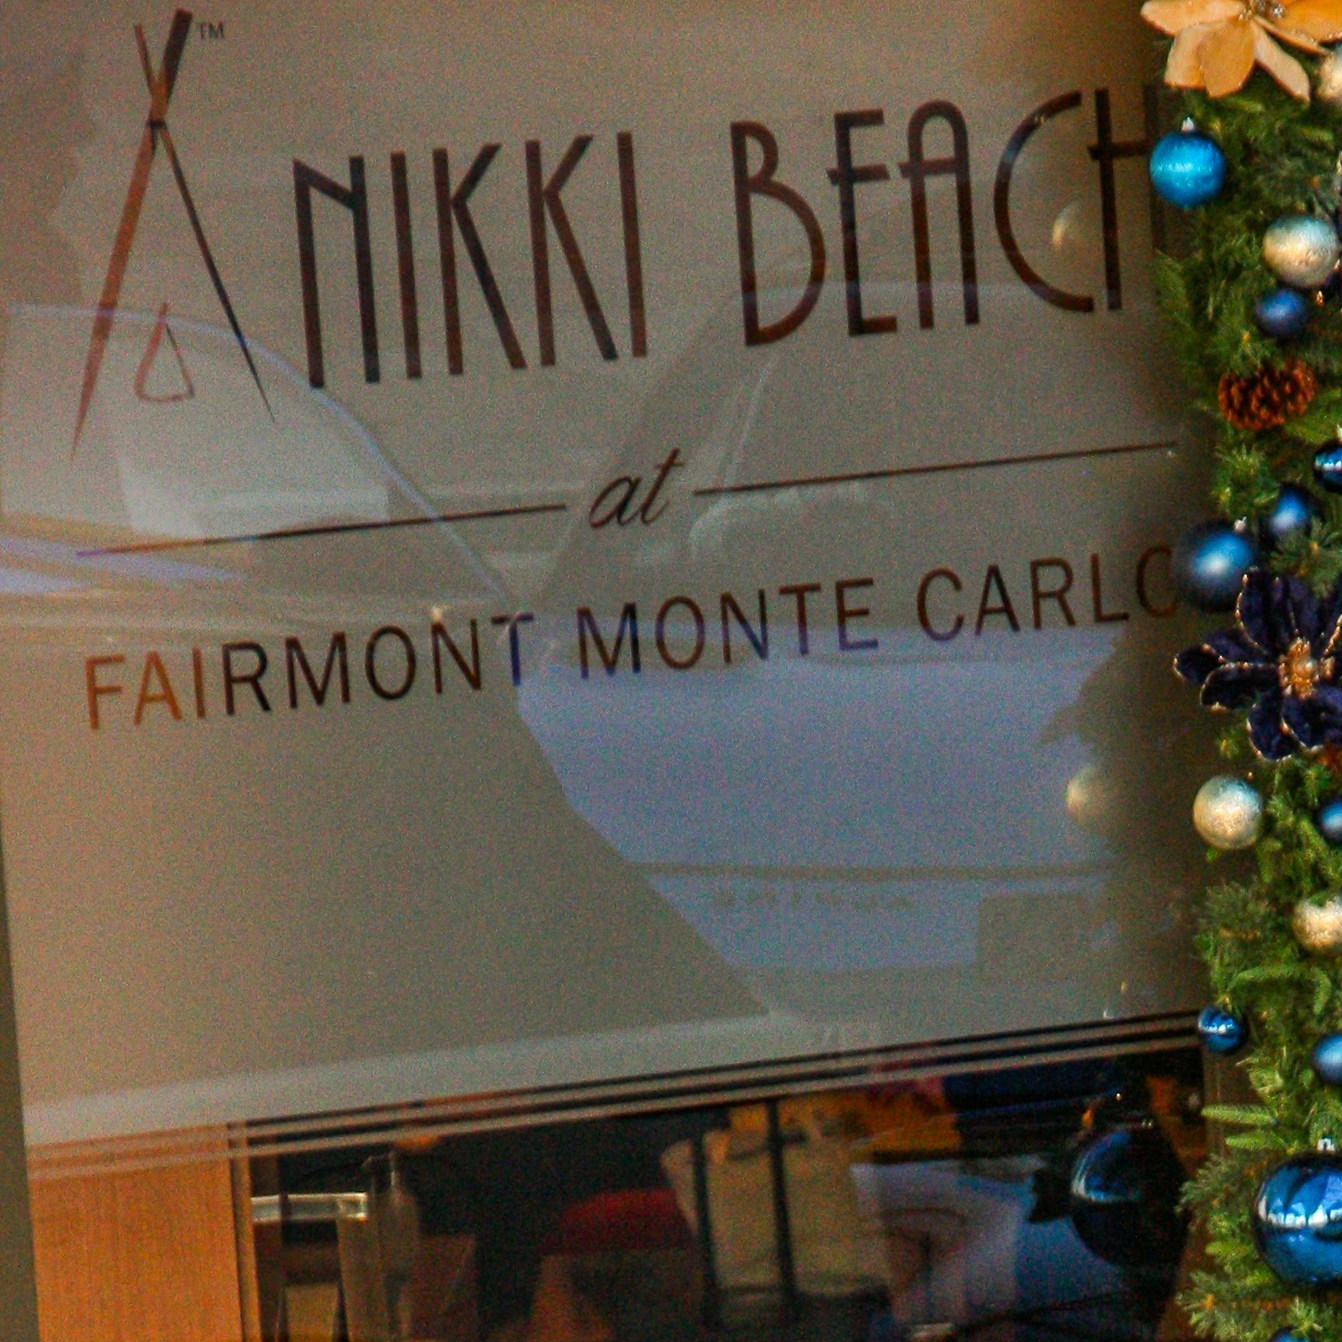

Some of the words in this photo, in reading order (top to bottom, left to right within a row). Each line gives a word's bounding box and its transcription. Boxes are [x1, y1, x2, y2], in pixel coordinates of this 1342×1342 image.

[293, 131, 648, 389] NIKKI
[730, 84, 1165, 348] BEACH
[589, 448, 682, 528] at
[85, 612, 534, 730] FAIRMONT
[575, 576, 879, 681] MONTE
